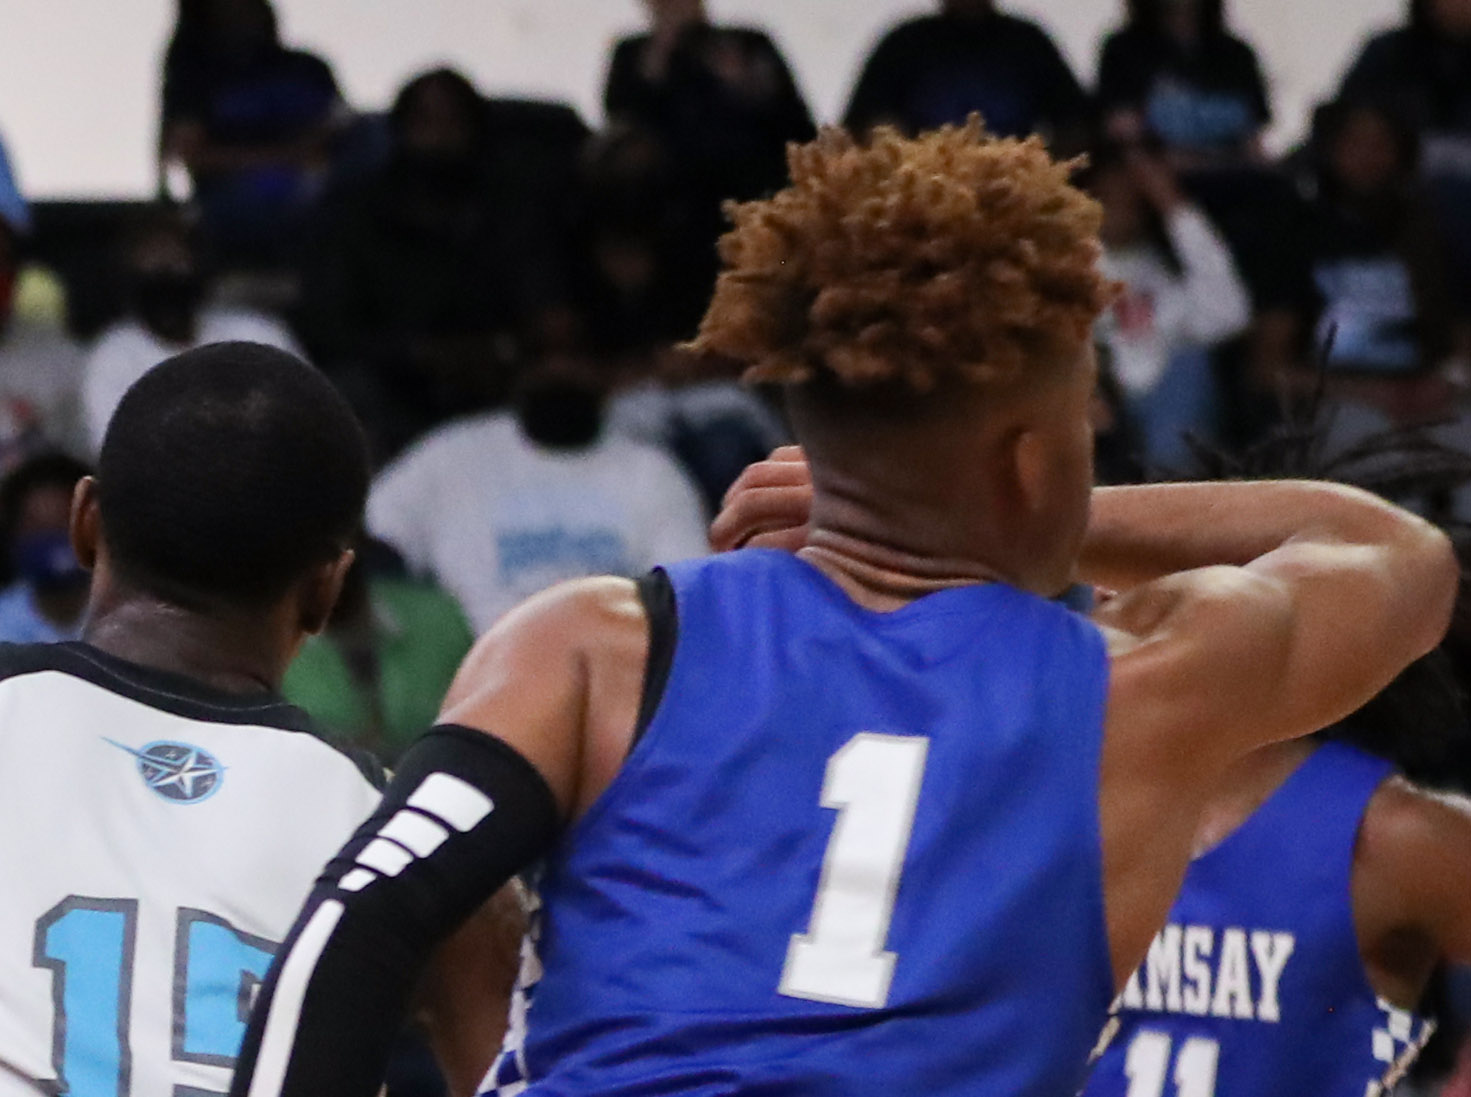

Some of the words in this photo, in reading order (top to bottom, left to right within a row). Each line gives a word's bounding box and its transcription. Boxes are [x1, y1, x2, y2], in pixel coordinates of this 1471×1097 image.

[778, 732, 929, 1008] 1
[1108, 922, 1295, 1023] MSAY
[1124, 1029, 1220, 1097] 11
